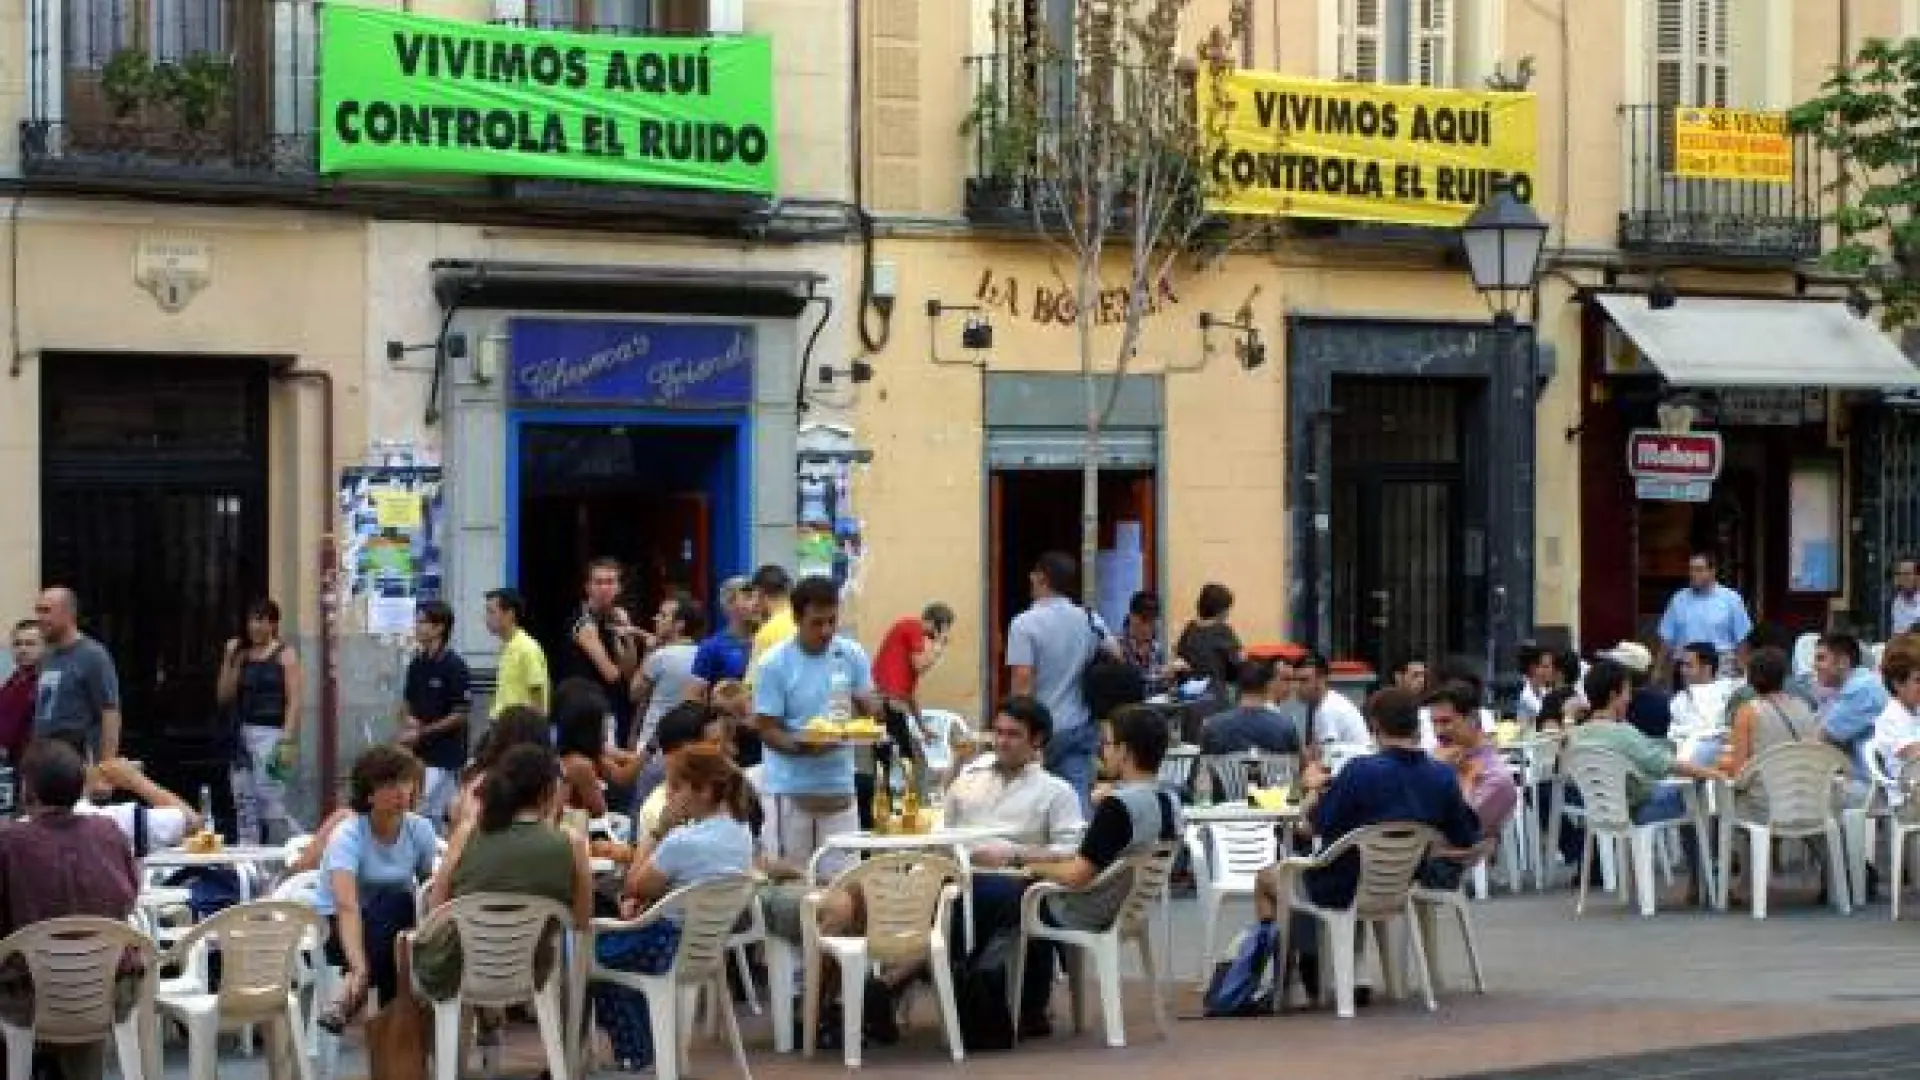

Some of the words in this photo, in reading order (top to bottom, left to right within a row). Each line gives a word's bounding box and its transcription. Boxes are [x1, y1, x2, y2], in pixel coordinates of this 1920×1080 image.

[394, 31, 588, 88] VIVIMOS
[604, 46, 710, 96] AQUÍ
[335, 100, 568, 154] CONTROLA
[582, 116, 625, 157] EL
[638, 119, 768, 166] RUIDO
[1254, 91, 1398, 139] VIVIMOS
[1410, 101, 1492, 147] AQUÍ
[1212, 147, 1384, 200] CONTROLA
[1394, 163, 1428, 199] EL
